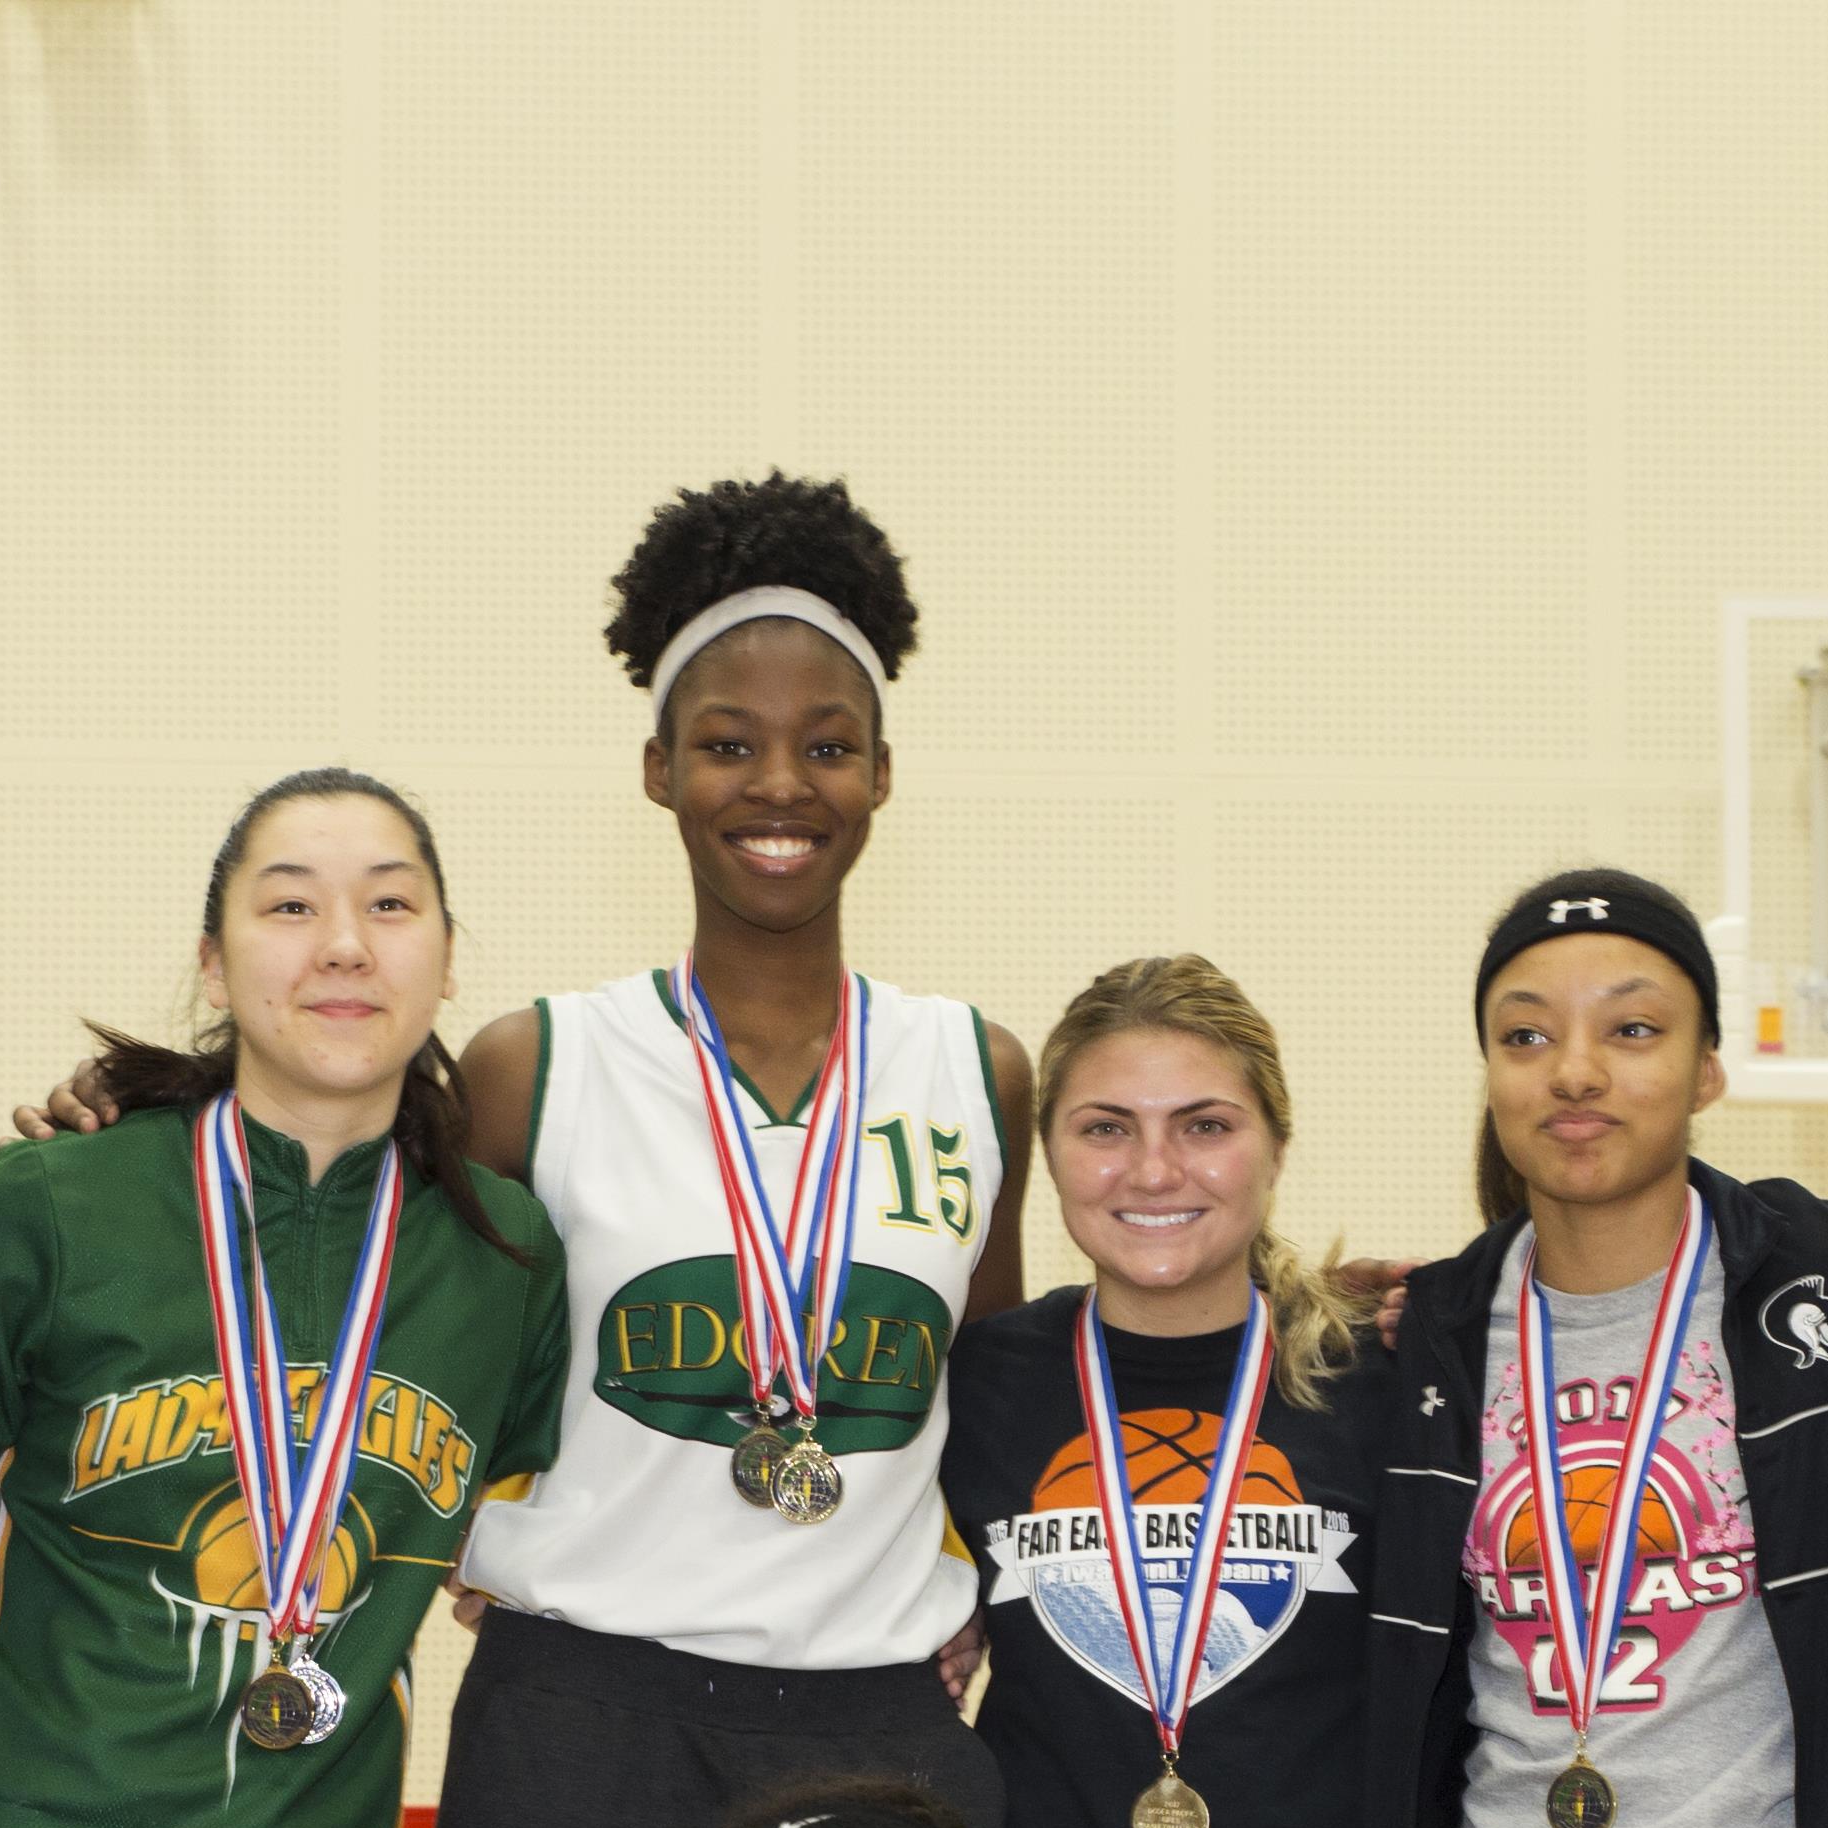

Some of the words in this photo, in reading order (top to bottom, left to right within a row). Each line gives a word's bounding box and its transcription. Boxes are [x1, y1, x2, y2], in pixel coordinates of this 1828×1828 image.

[863, 1112, 977, 1245] 15
[254, 1361, 478, 1520] EGLES
[1018, 1518, 1062, 1560] FAR
[1145, 1511, 1319, 1555] BASETBALL
